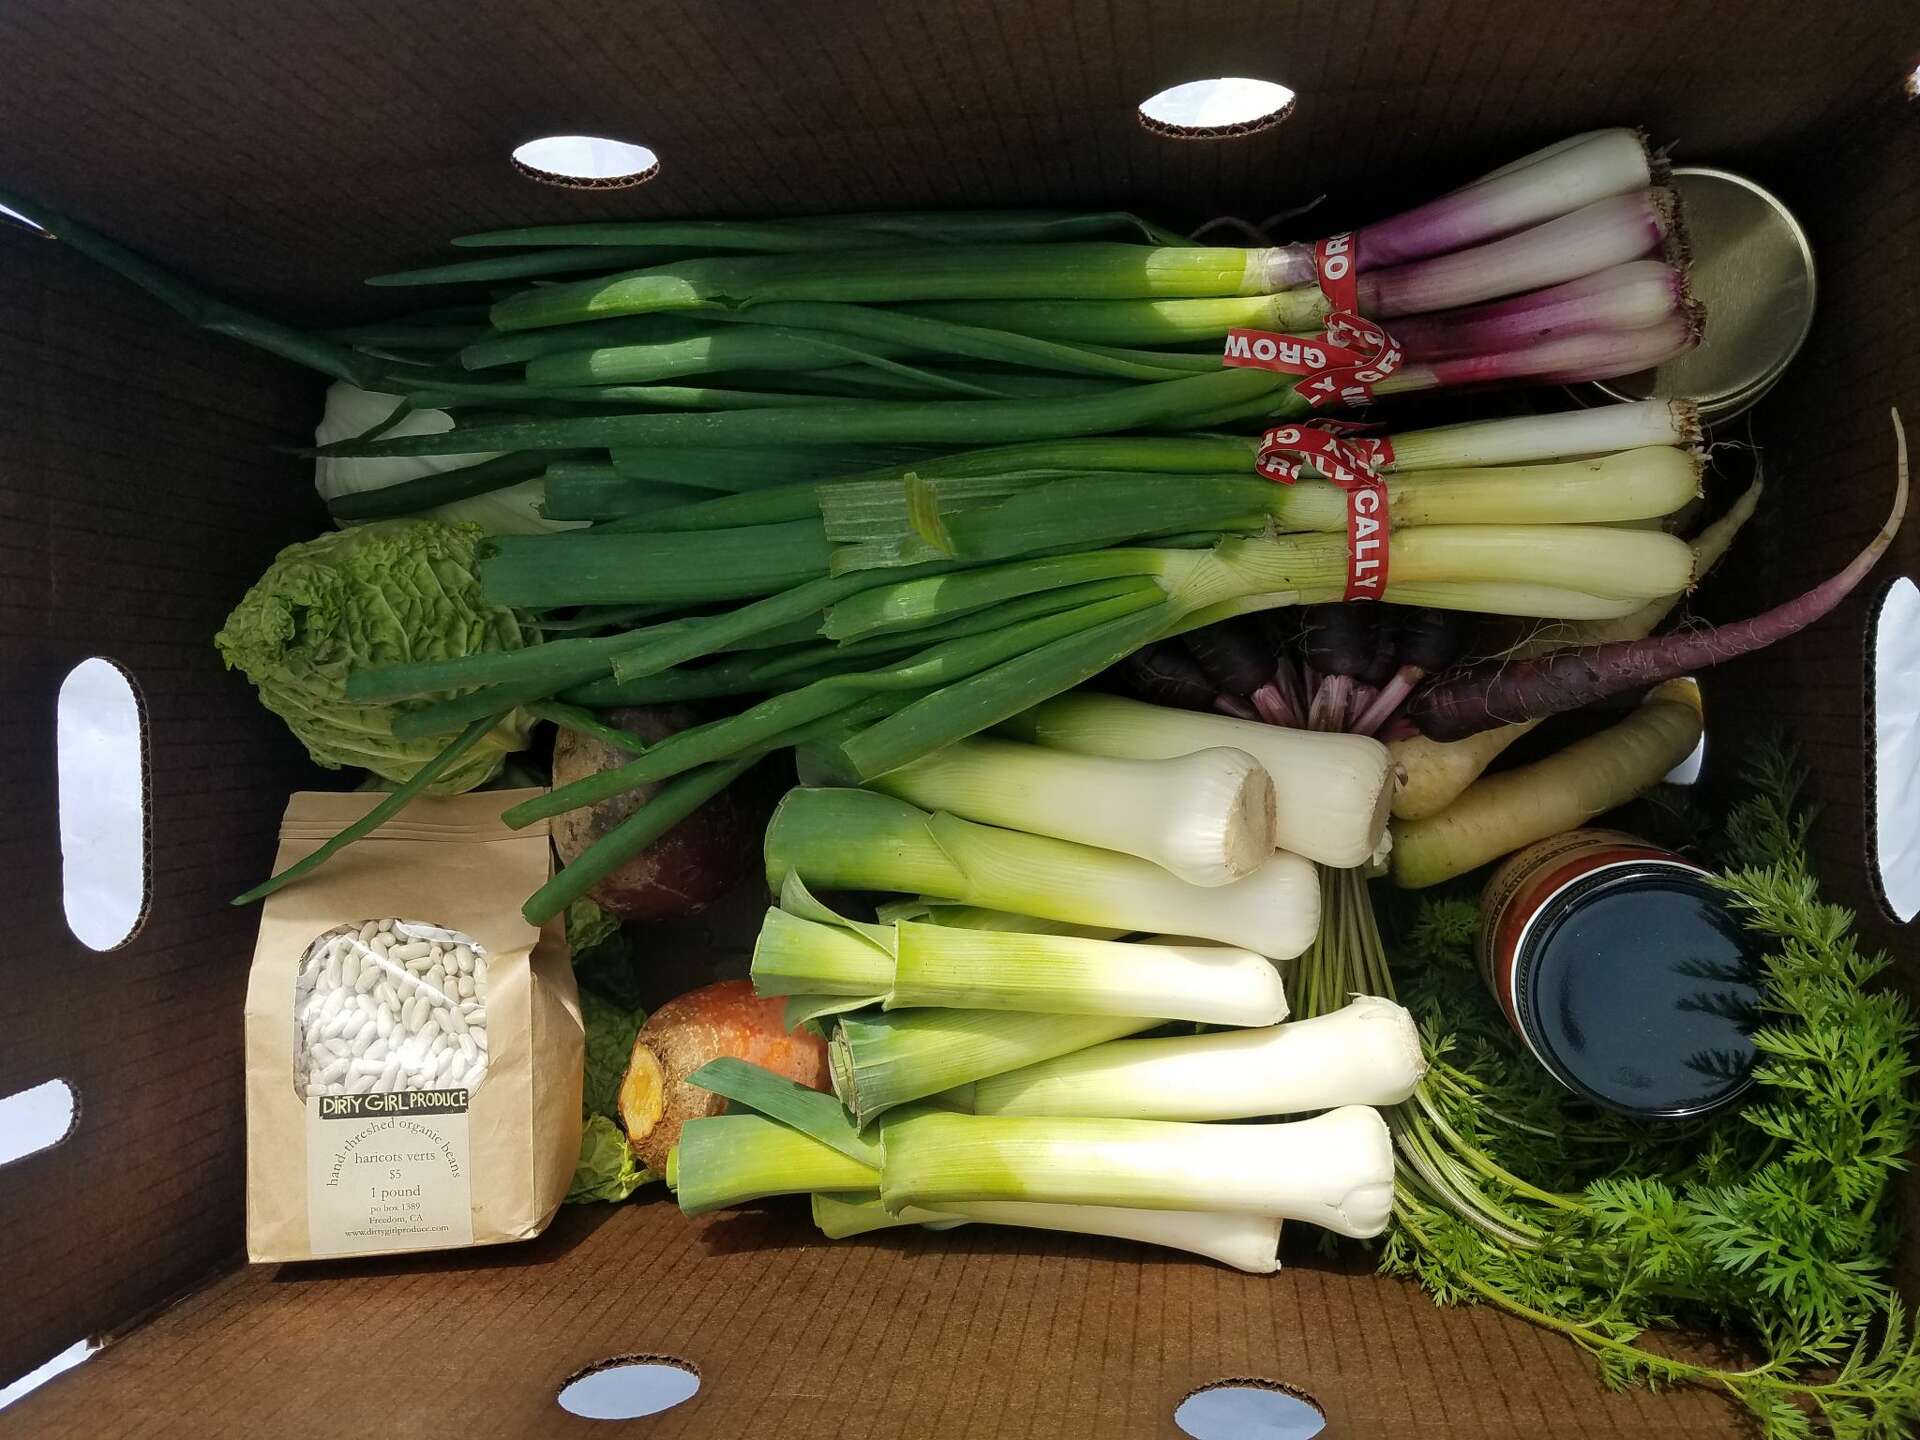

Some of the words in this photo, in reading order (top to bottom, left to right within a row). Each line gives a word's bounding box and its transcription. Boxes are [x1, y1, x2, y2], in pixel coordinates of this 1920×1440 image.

[410, 1090, 467, 1108] PRODUCE
[399, 1120, 443, 1145] organic
[441, 1141, 461, 1178] beans
[354, 1152, 403, 1164] haricots
[407, 1151, 436, 1162] verts
[389, 1169, 401, 1180] $5
[371, 1187, 376, 1198] 1
[381, 1185, 421, 1201] pound
[383, 1204, 399, 1212] box
[401, 1202, 421, 1211] 1389
[369, 1216, 408, 1225] Freedom,
[409, 1214, 423, 1223] CA
[344, 1225, 449, 1238] www.dirtygirlproduce.com
